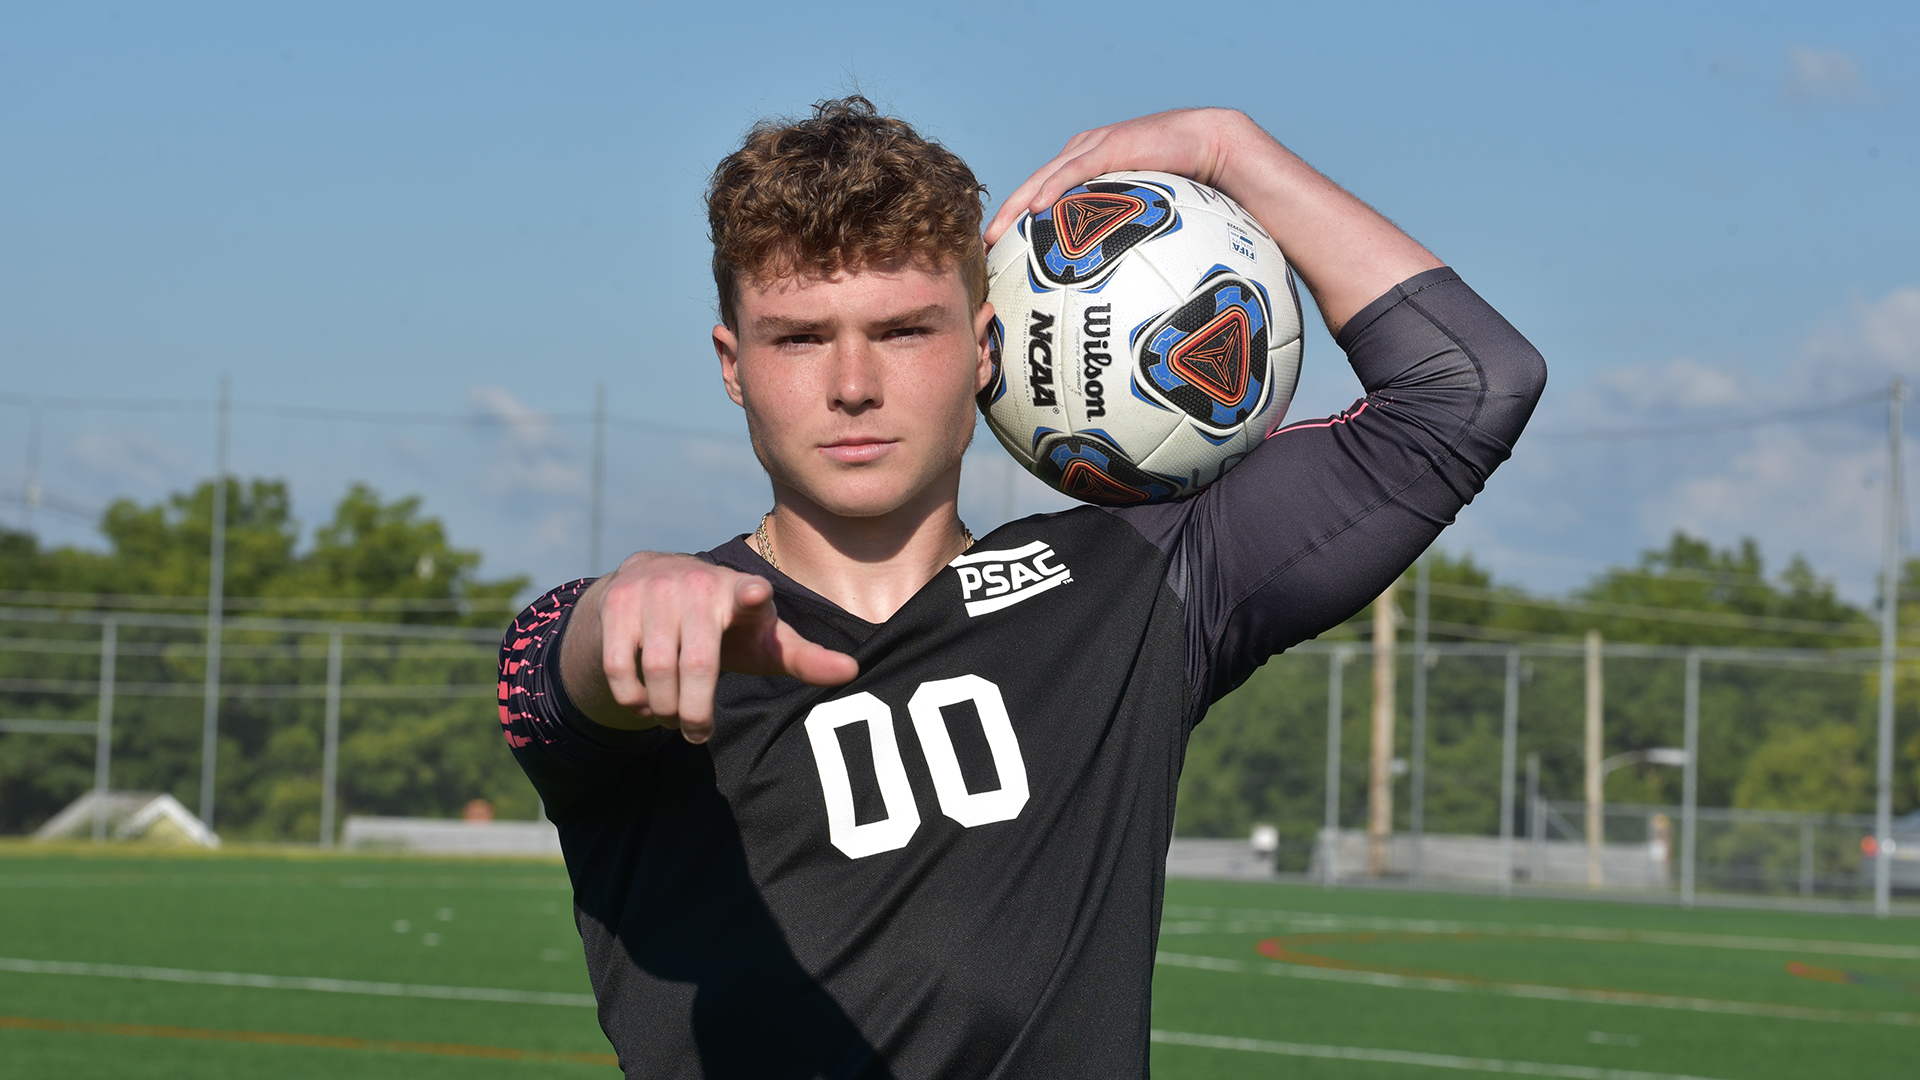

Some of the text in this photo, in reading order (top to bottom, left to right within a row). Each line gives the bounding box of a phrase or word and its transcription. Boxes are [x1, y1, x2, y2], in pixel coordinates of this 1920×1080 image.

[1232, 242, 1255, 260] FIFA
[1028, 309, 1057, 407] NCAA
[1083, 303, 1112, 419] Wilson
[957, 549, 1066, 599] PSAC
[804, 673, 1030, 860] 00
